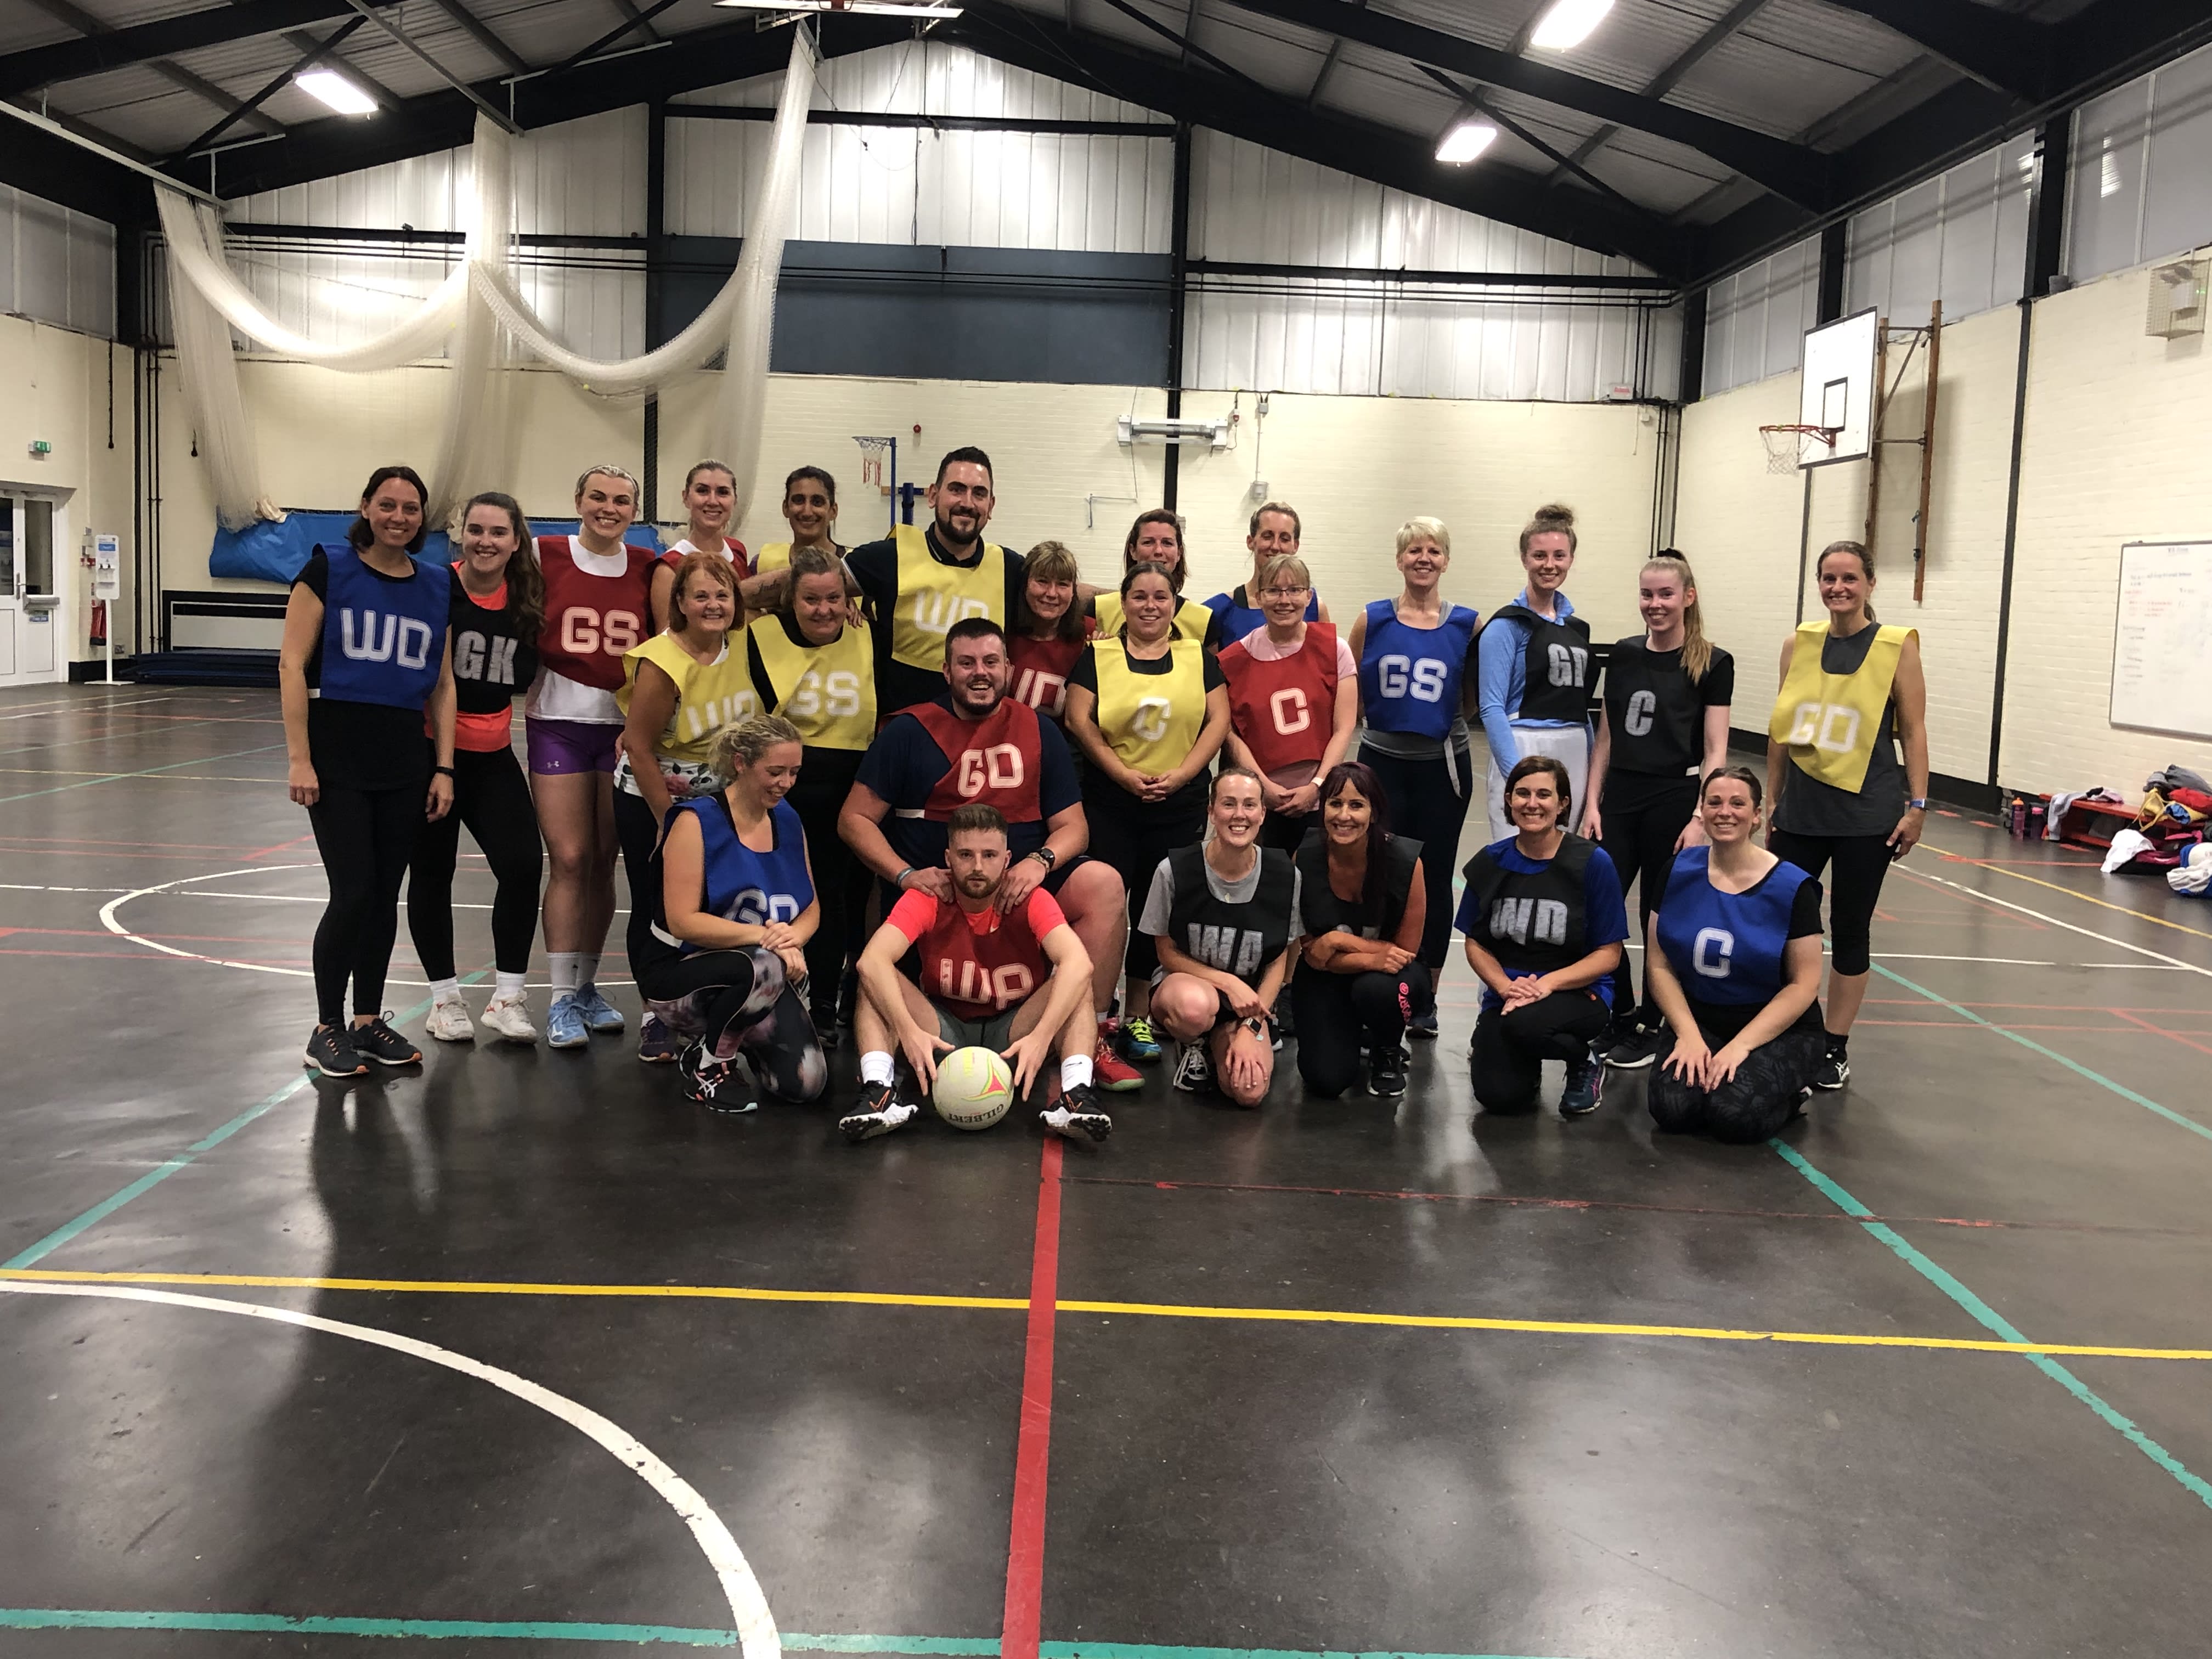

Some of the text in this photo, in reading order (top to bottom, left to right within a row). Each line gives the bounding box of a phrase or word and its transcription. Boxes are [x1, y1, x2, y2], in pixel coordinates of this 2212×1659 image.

[340, 608, 432, 670] WD
[561, 607, 639, 657] GS
[453, 630, 518, 685] GK
[1378, 654, 1447, 703] GS
[787, 669, 860, 716] GS
[1271, 687, 1310, 735] C
[1624, 690, 1656, 736] C
[1132, 697, 1172, 742] C
[1789, 702, 1860, 752] GD
[958, 743, 1024, 797] GD
[1489, 898, 1567, 946] WD
[1188, 923, 1263, 976] WA
[1693, 927, 1734, 979] C
[949, 1103, 1004, 1123] GILBERT
